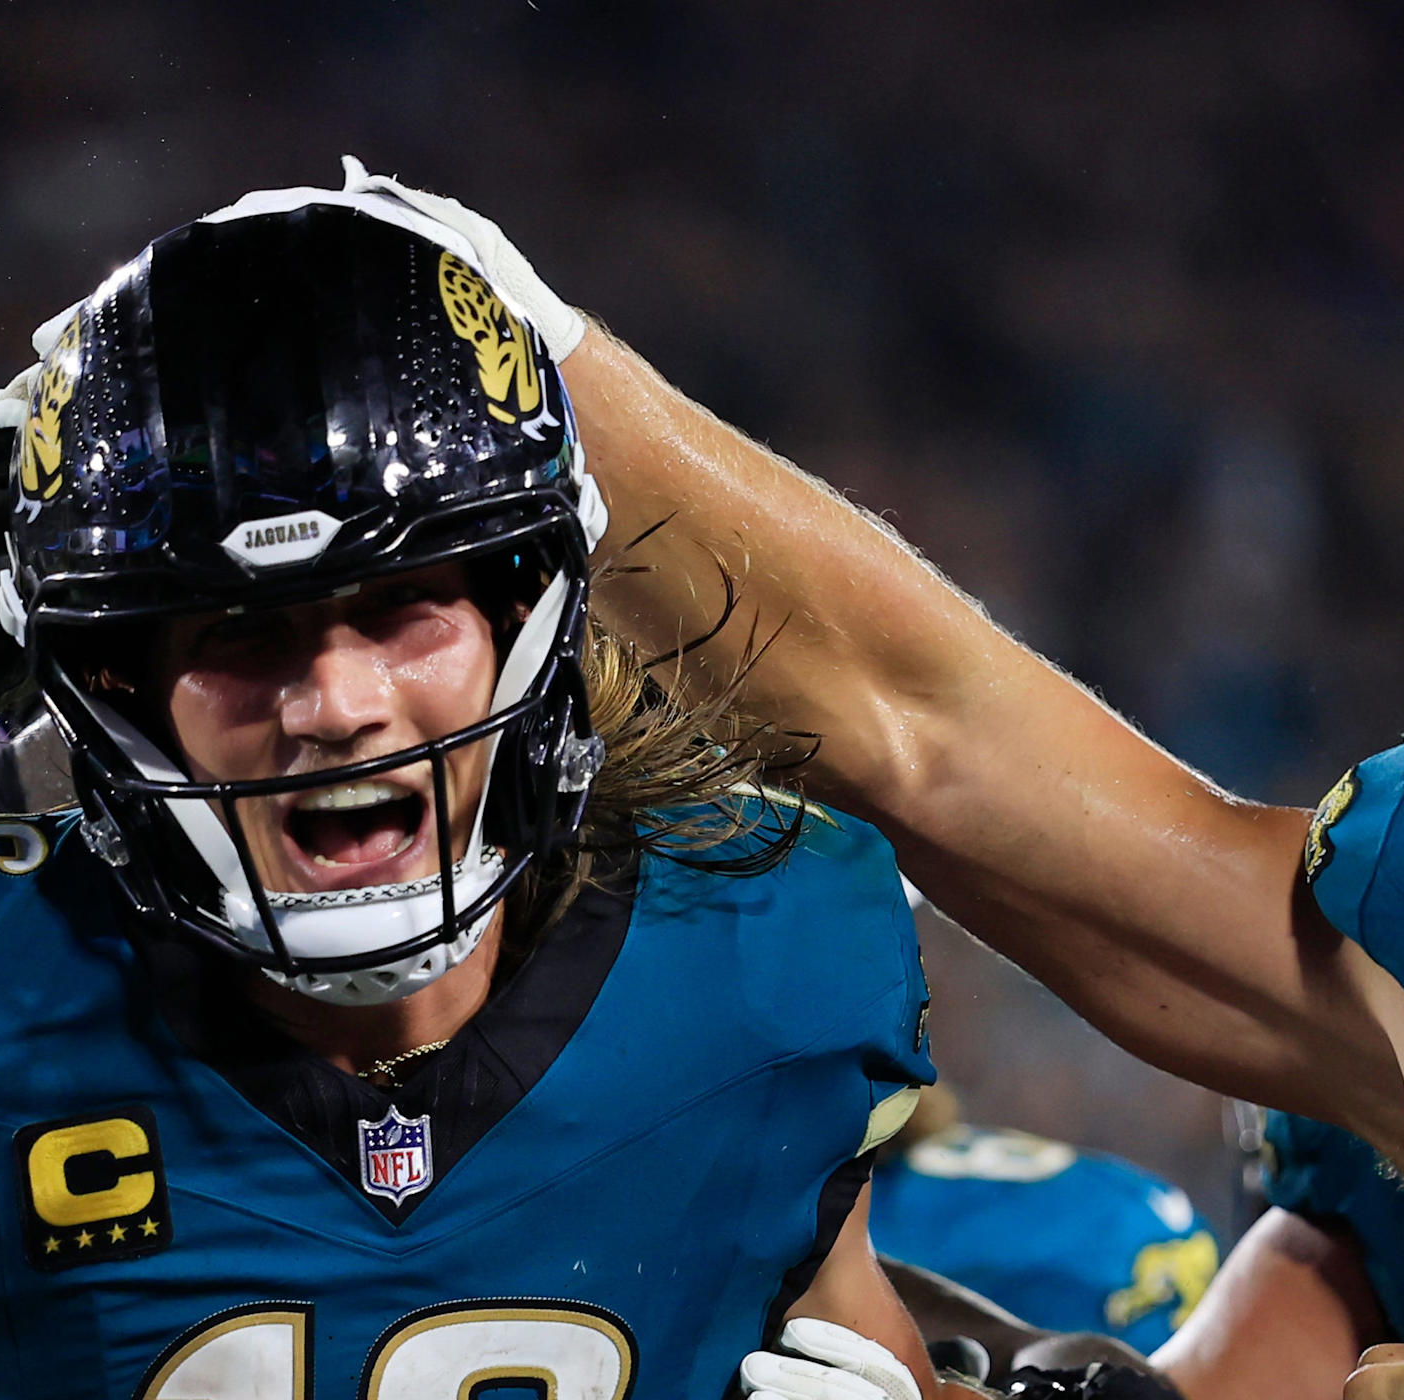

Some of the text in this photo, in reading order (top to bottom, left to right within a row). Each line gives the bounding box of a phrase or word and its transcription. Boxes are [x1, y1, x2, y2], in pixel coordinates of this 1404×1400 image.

[245, 521, 320, 549] JAGUARS
[28, 1118, 155, 1227] C
[371, 1151, 421, 1187] NFL
